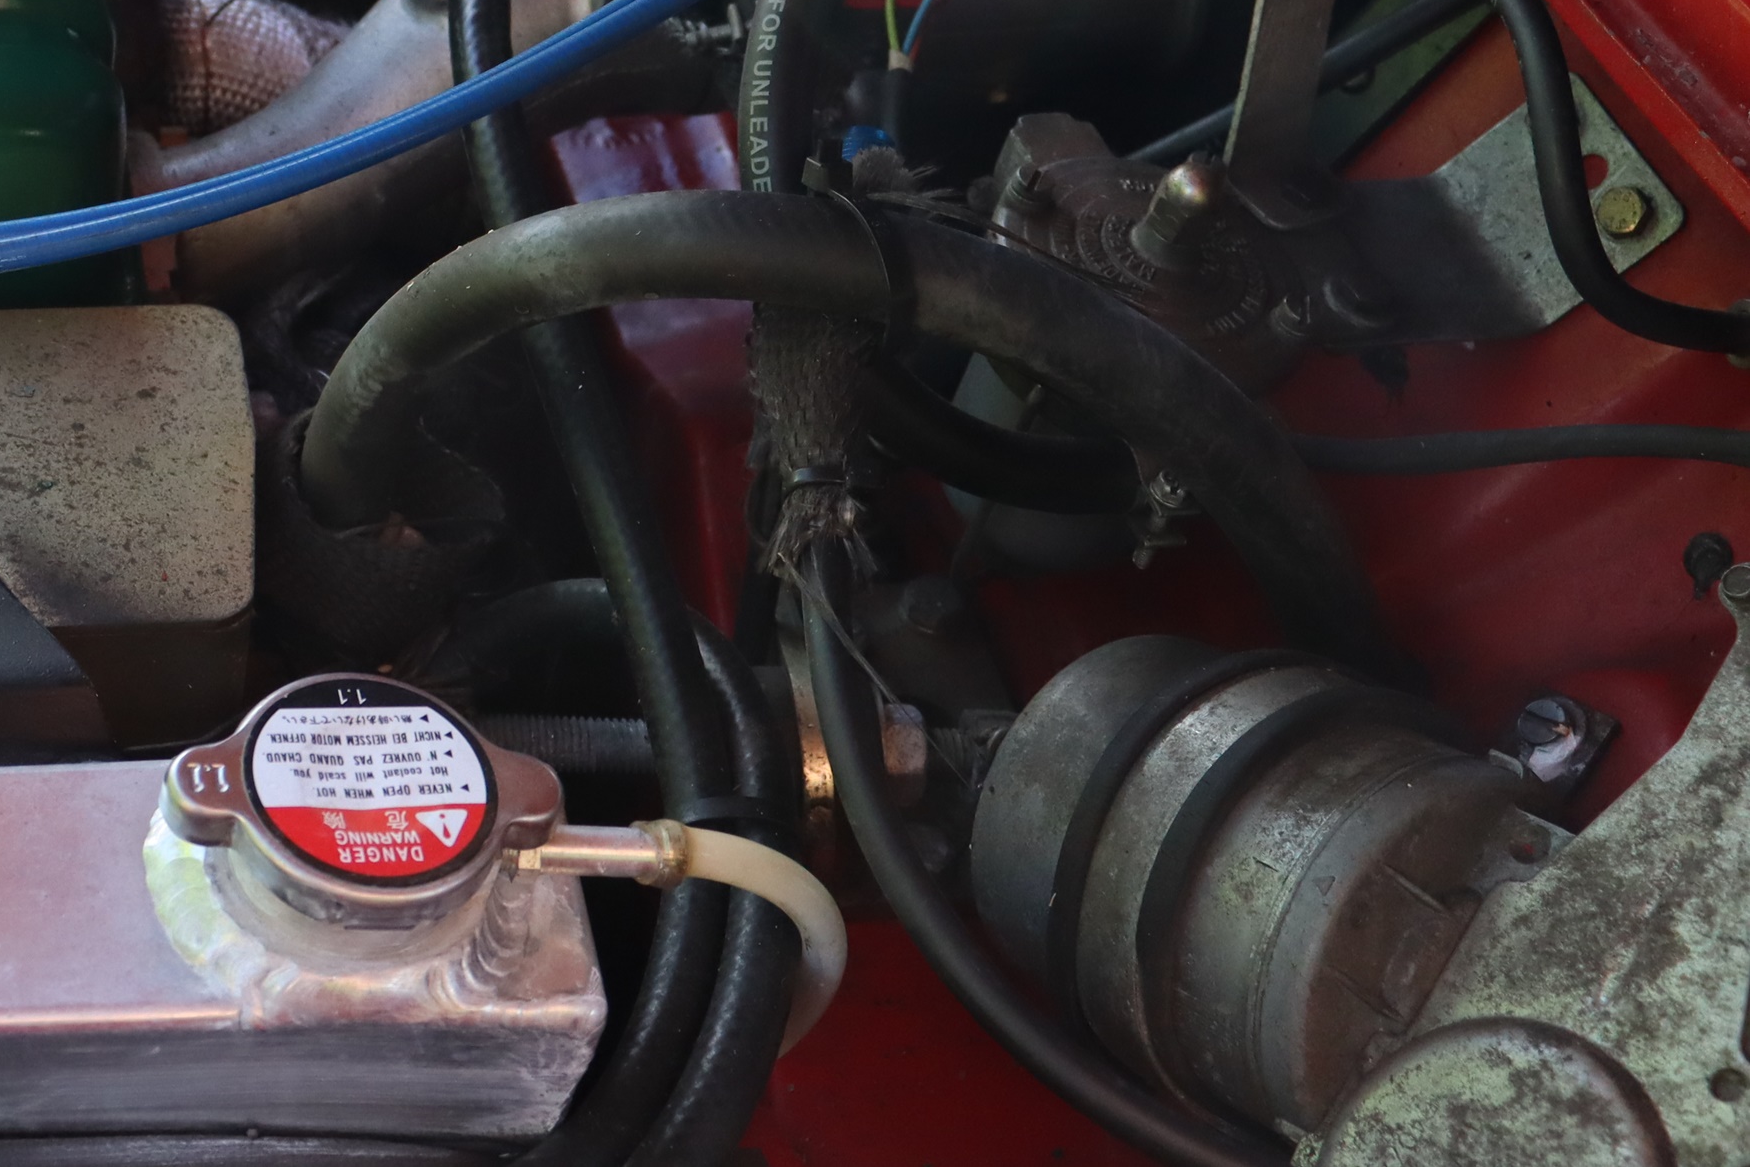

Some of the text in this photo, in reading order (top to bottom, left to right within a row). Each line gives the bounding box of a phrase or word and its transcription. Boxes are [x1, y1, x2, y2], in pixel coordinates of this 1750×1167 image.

[337, 688, 367, 705] 1.1
[311, 734, 342, 745] MOTOR
[346, 734, 388, 745] HEISSEM
[392, 732, 408, 743] BEI
[414, 730, 442, 742] NICHT
[262, 751, 303, 764] CHAUD.
[309, 753, 344, 766] QUAND
[353, 754, 373, 765] PAS
[382, 751, 422, 764] OUVREZ
[186, 762, 230, 793] 1.1
[290, 766, 449, 782] Hot coolant will scald you.
[344, 787, 375, 799] WHEN
[382, 785, 411, 797] OPEN
[418, 783, 453, 795] NEVER
[335, 830, 421, 846] WARNING
[338, 845, 425, 863] DANGER
